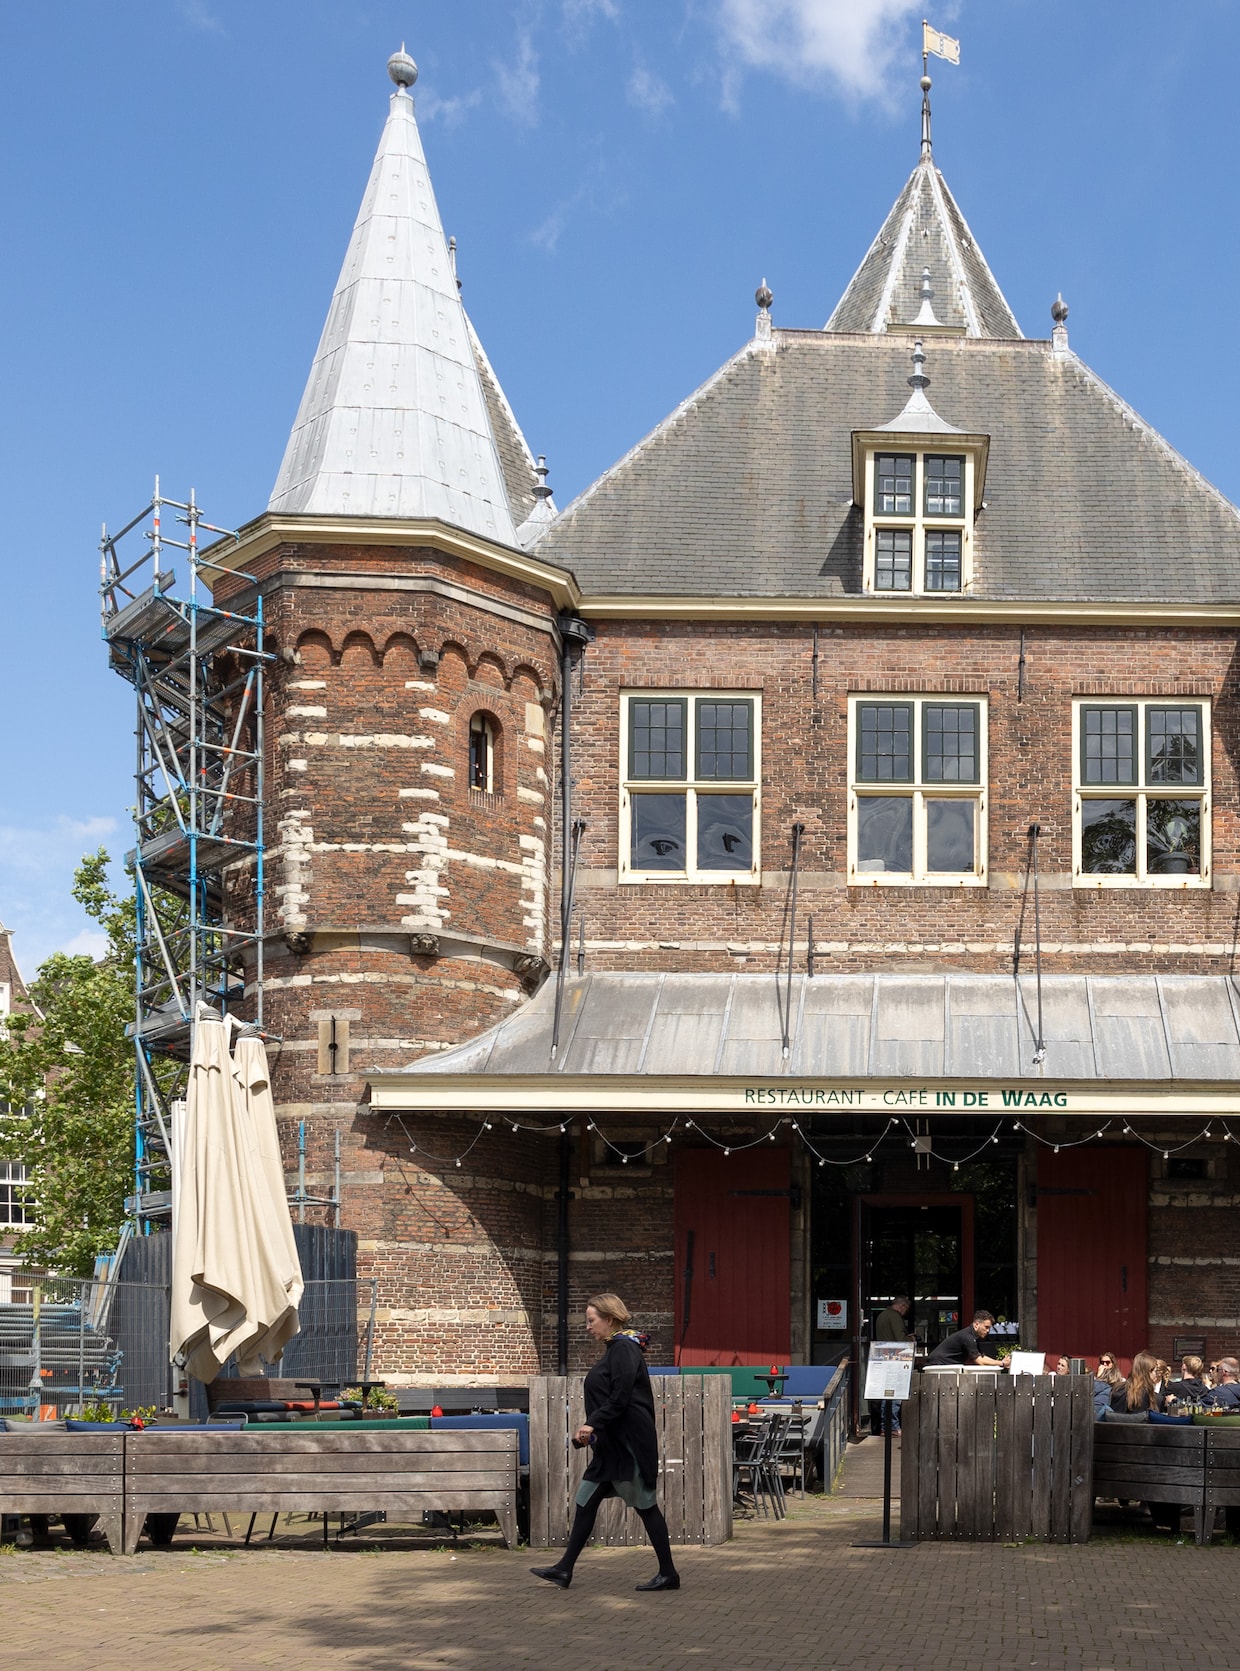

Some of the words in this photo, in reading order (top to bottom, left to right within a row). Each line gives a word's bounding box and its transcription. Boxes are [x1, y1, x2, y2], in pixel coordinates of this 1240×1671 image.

[745, 1089, 865, 1105] RESTAURANT
[883, 1087, 928, 1105] CAFÉ
[936, 1092, 956, 1106] IN
[963, 1092, 989, 1106] DE
[1001, 1090, 1068, 1107] WAAG
